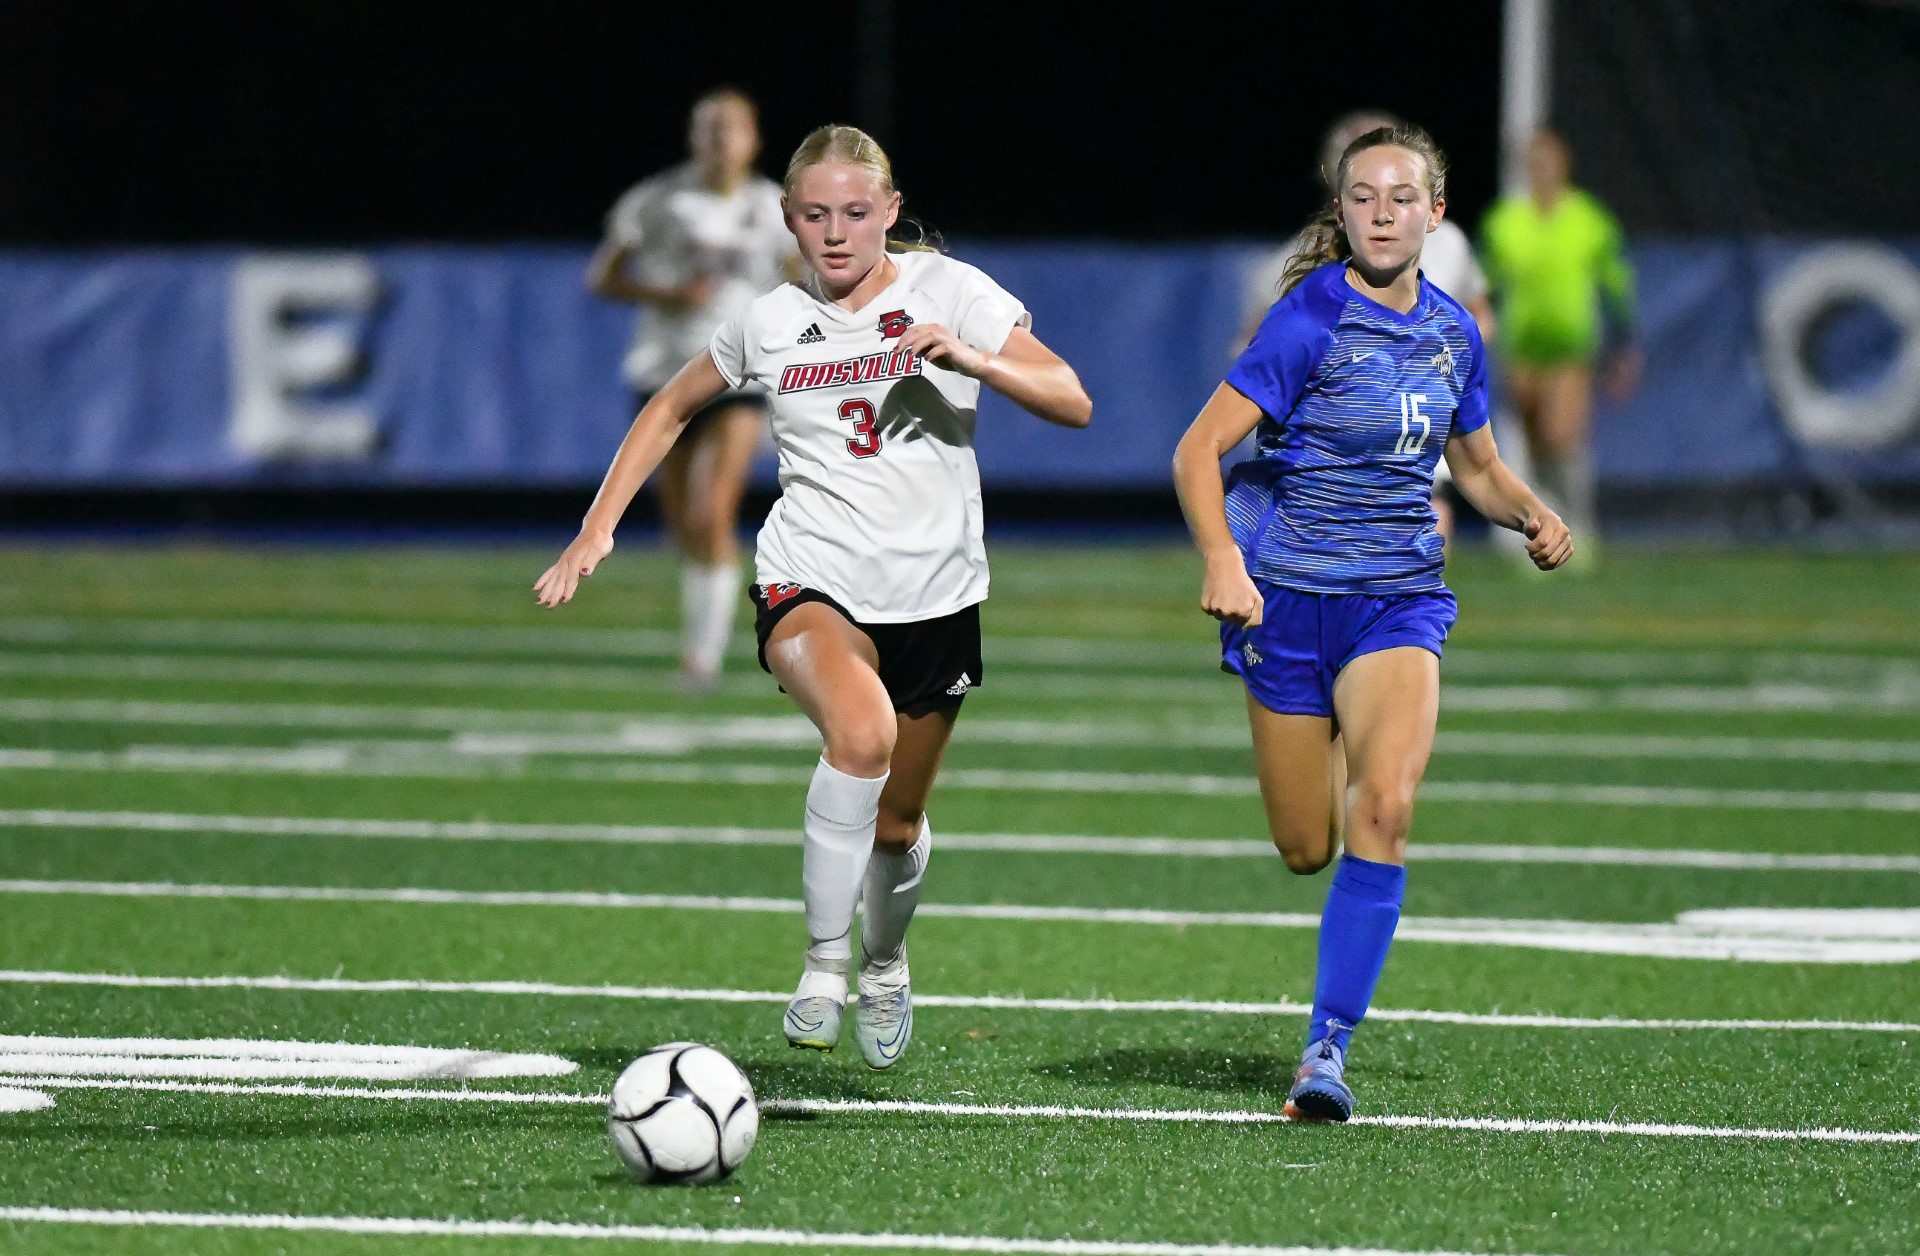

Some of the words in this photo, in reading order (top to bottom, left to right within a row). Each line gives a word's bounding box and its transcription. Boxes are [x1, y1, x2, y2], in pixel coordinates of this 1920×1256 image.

[230, 255, 380, 458] E
[797, 335, 827, 345] adidas
[778, 348, 922, 395] DANSVILLE
[837, 397, 883, 459] 3
[1394, 393, 1431, 454] 15
